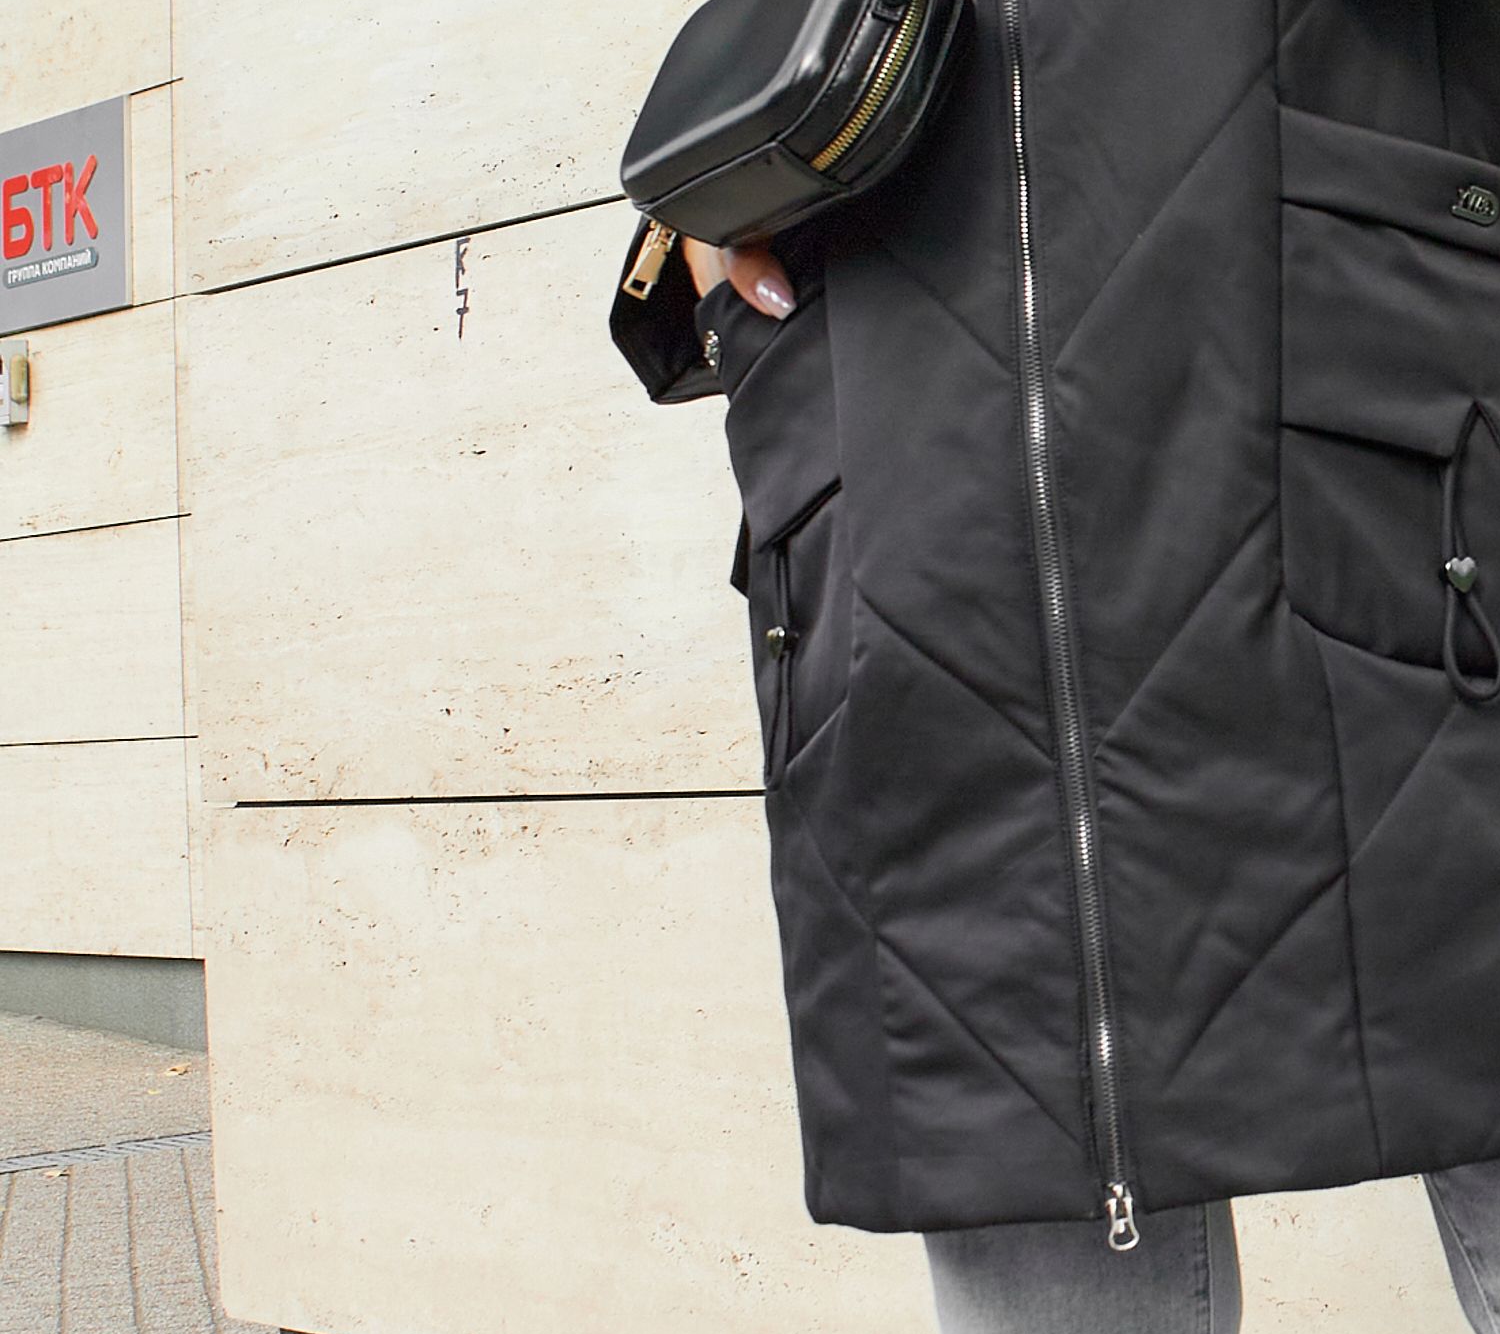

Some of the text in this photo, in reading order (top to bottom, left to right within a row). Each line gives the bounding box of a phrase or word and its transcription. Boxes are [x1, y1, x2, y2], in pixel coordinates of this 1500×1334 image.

[3, 155, 98, 259] БТК
[8, 249, 91, 283] ГРУППА КОМПАНИЙ
